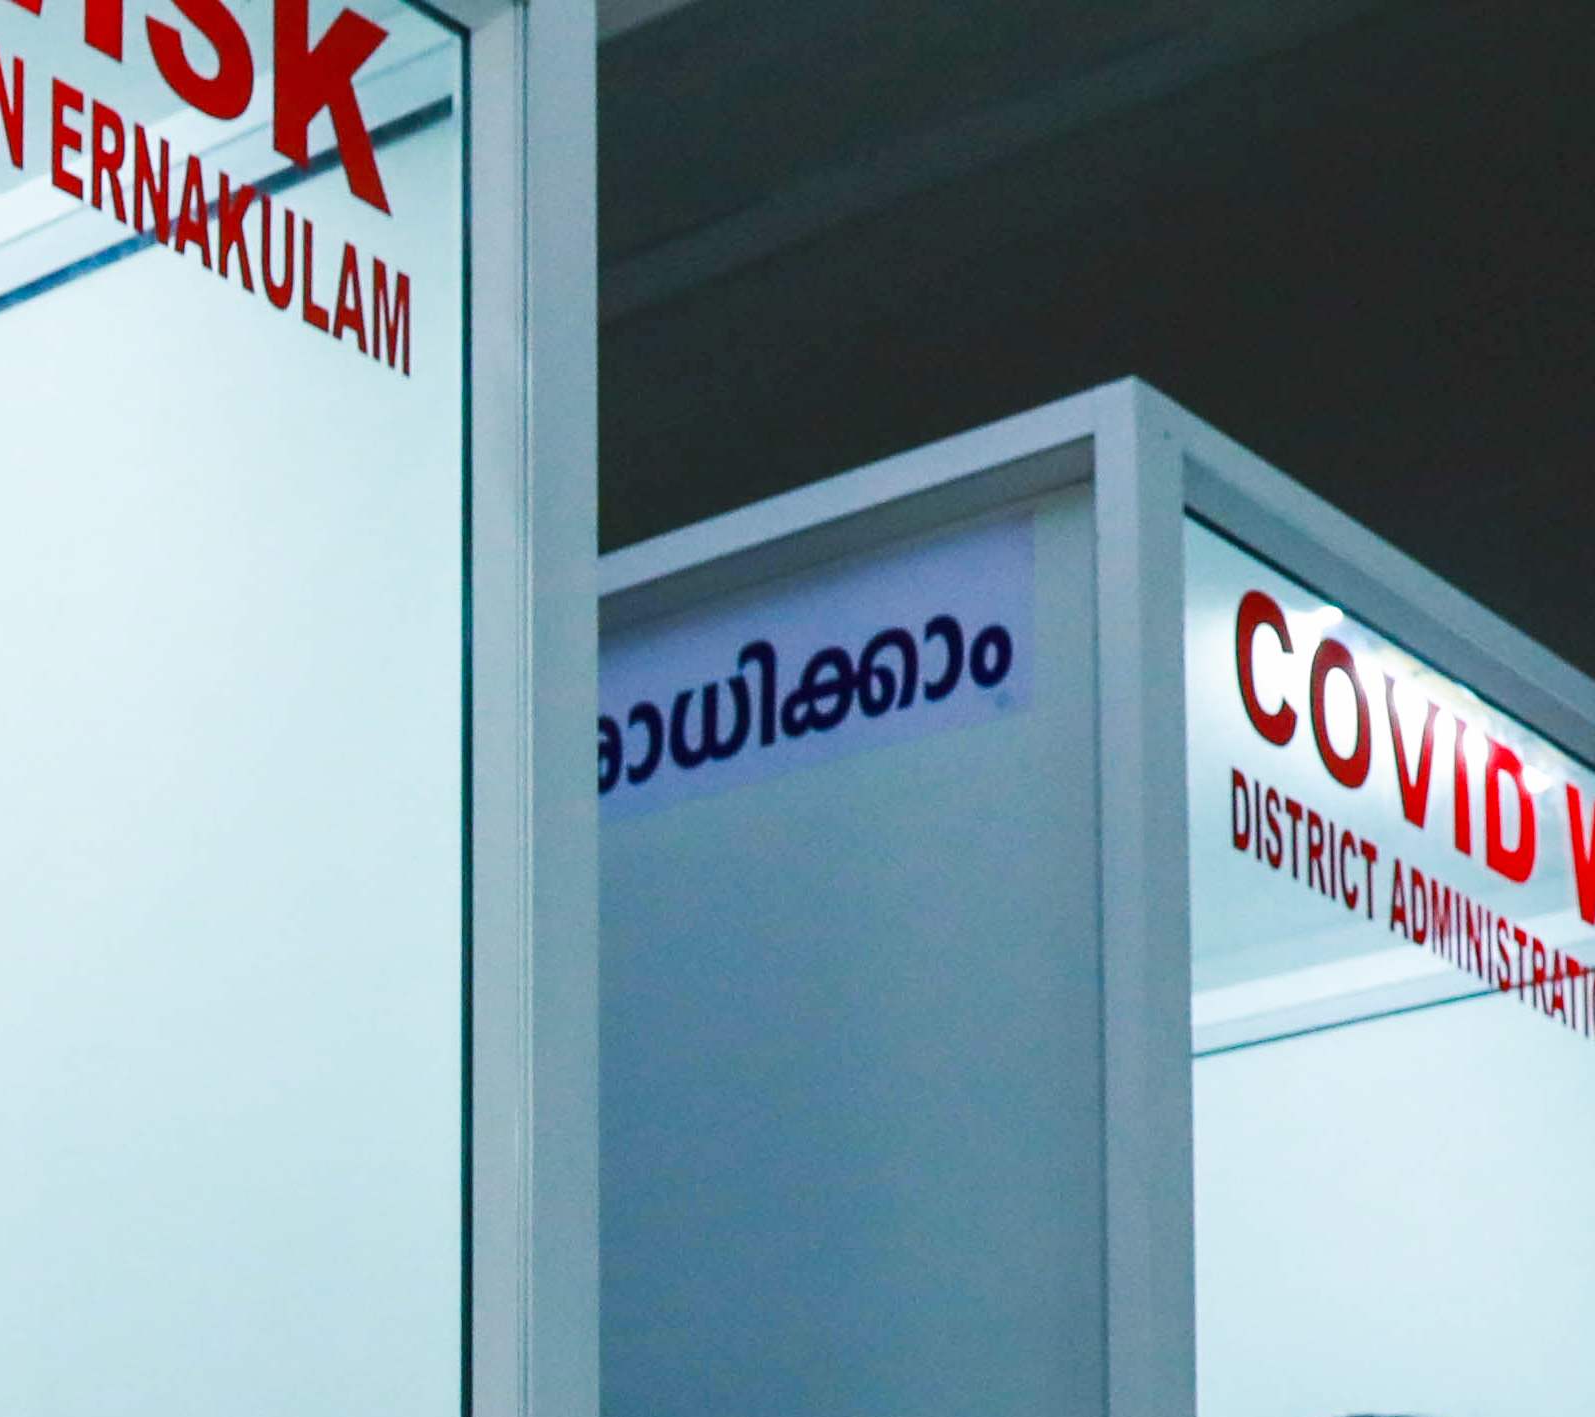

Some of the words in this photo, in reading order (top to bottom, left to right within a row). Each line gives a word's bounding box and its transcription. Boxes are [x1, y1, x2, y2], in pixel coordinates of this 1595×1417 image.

[51, 76, 411, 378] ERNAKULAM
[1231, 766, 1378, 920] DISTRICT
[1235, 589, 1537, 884] COVID
